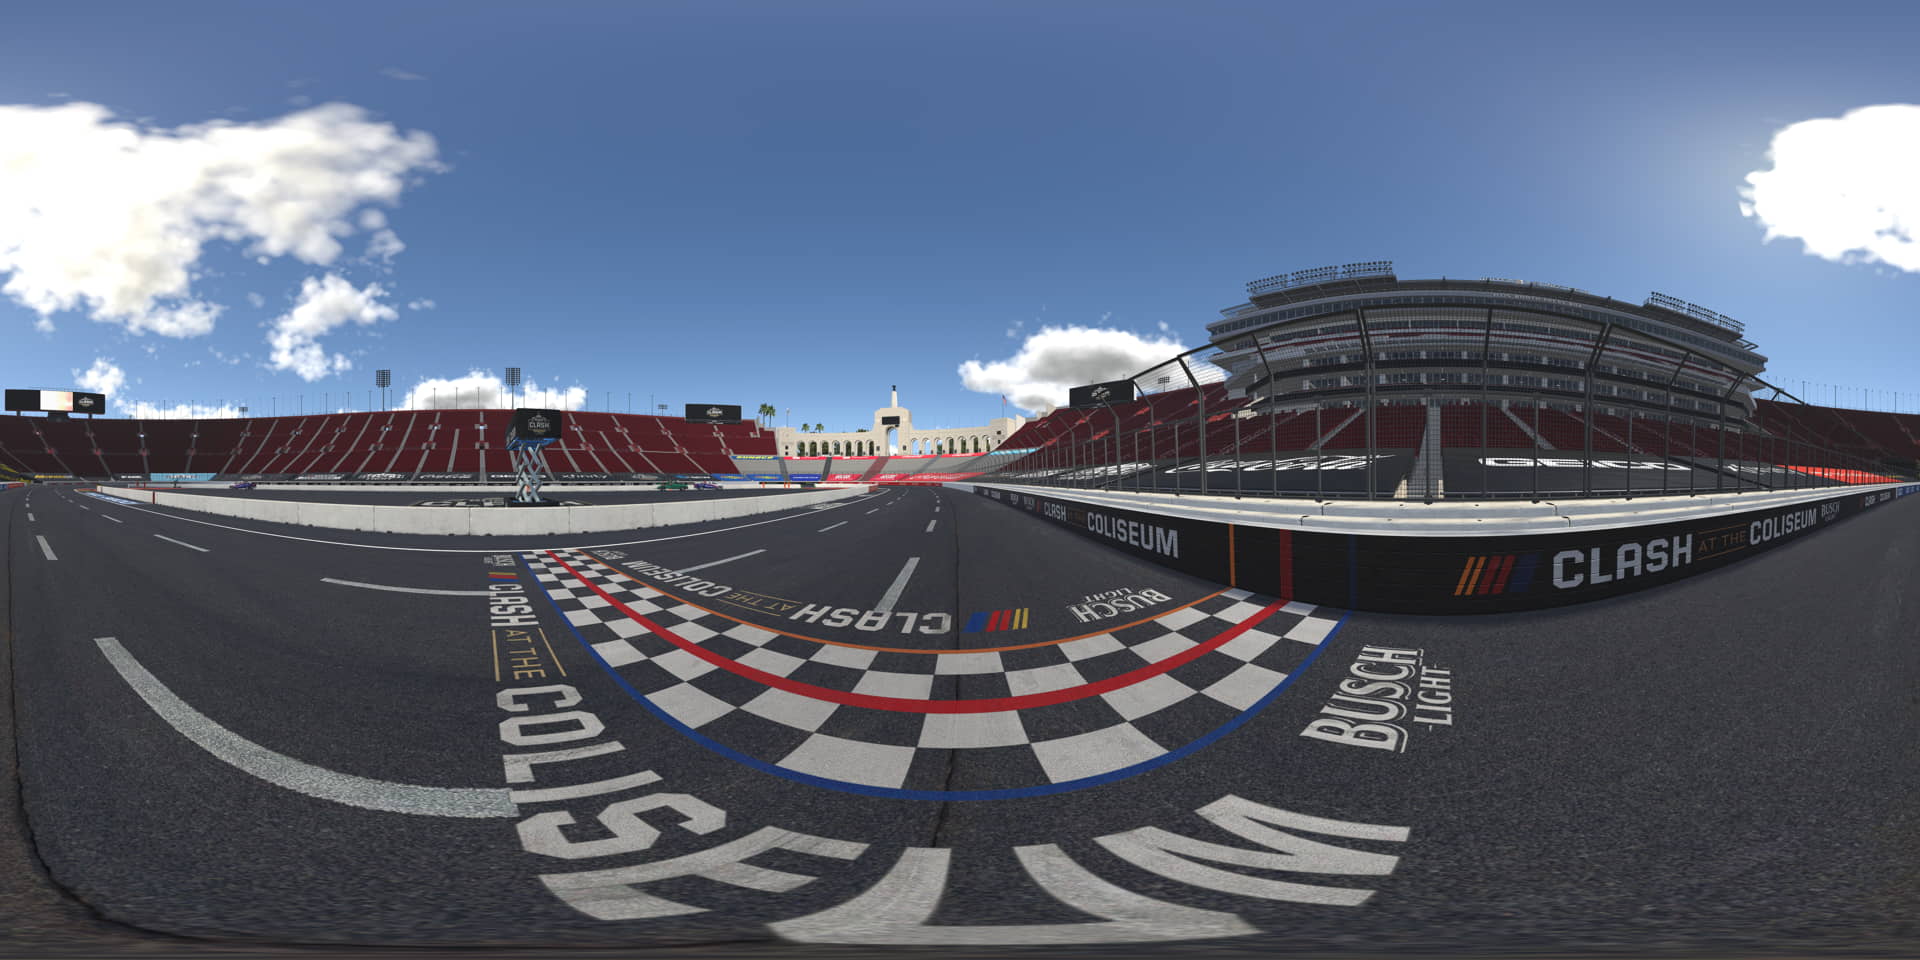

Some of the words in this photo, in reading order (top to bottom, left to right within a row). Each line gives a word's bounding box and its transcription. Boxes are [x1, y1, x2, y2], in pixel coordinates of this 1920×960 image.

[1043, 501, 1067, 521] CLASH
[1087, 511, 1179, 558] COLISEUM
[1553, 534, 1693, 589] CLASH
[1700, 537, 1716, 552] AT
[1723, 529, 1747, 548] THE
[1750, 508, 1817, 546] COLISEUM
[621, 560, 733, 598] COLISEUM
[1085, 587, 1133, 603] LIGHT
[489, 583, 539, 627] CLASH
[790, 603, 951, 634] CLASH
[1066, 588, 1172, 623] BUSCH
[504, 629, 532, 644] AT
[509, 647, 546, 680] THE
[1299, 644, 1424, 753] BUSCH
[496, 683, 1411, 946] COLISEUM
